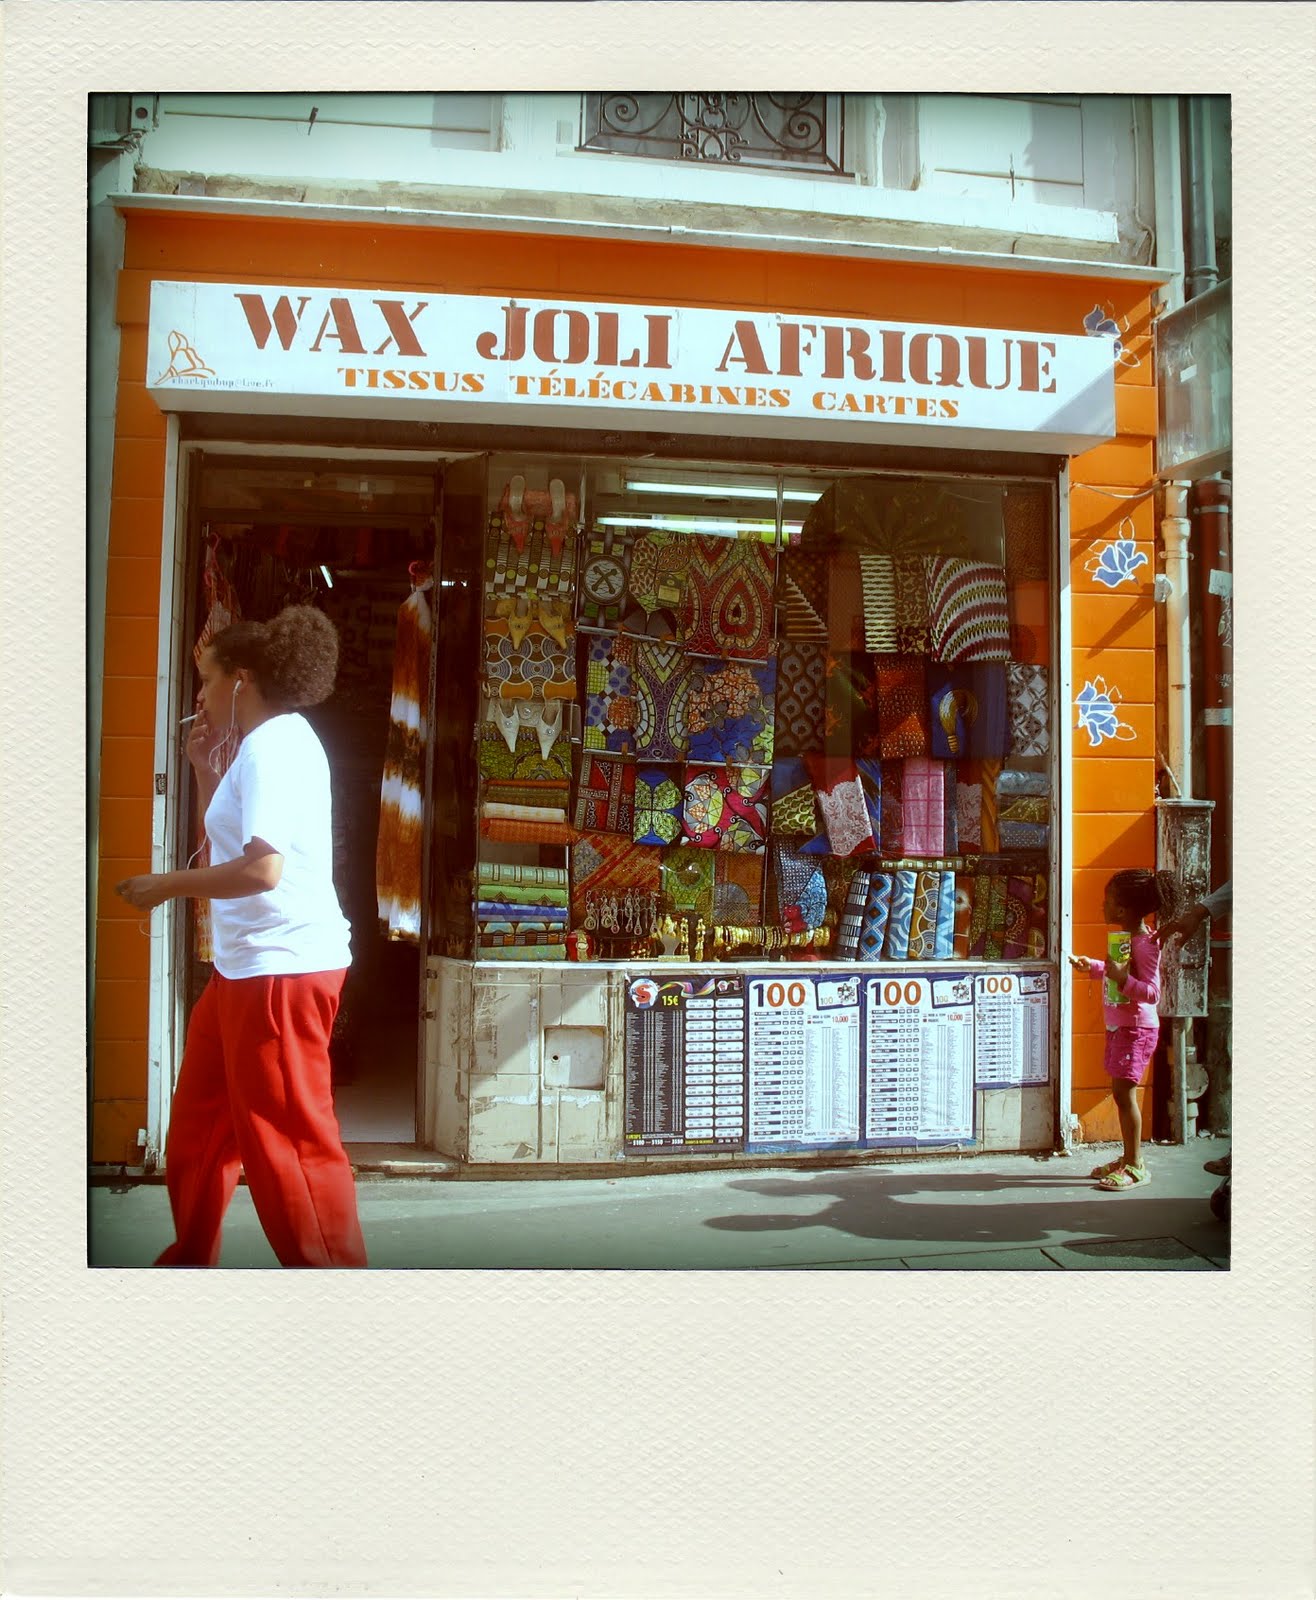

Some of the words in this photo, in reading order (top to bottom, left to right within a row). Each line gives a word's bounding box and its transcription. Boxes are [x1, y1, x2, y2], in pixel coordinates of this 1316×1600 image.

[233, 293, 429, 357] WAX
[476, 305, 673, 369] JOLI
[714, 319, 1057, 394] AFRIQUE
[337, 367, 485, 393] TISSUS
[509, 368, 792, 408] TÉLÉCABINES
[812, 390, 960, 419] CARTES
[752, 982, 806, 1008] 100
[870, 980, 922, 1007] 100
[977, 976, 1013, 994] 100
[661, 995, 679, 1006] 15€
